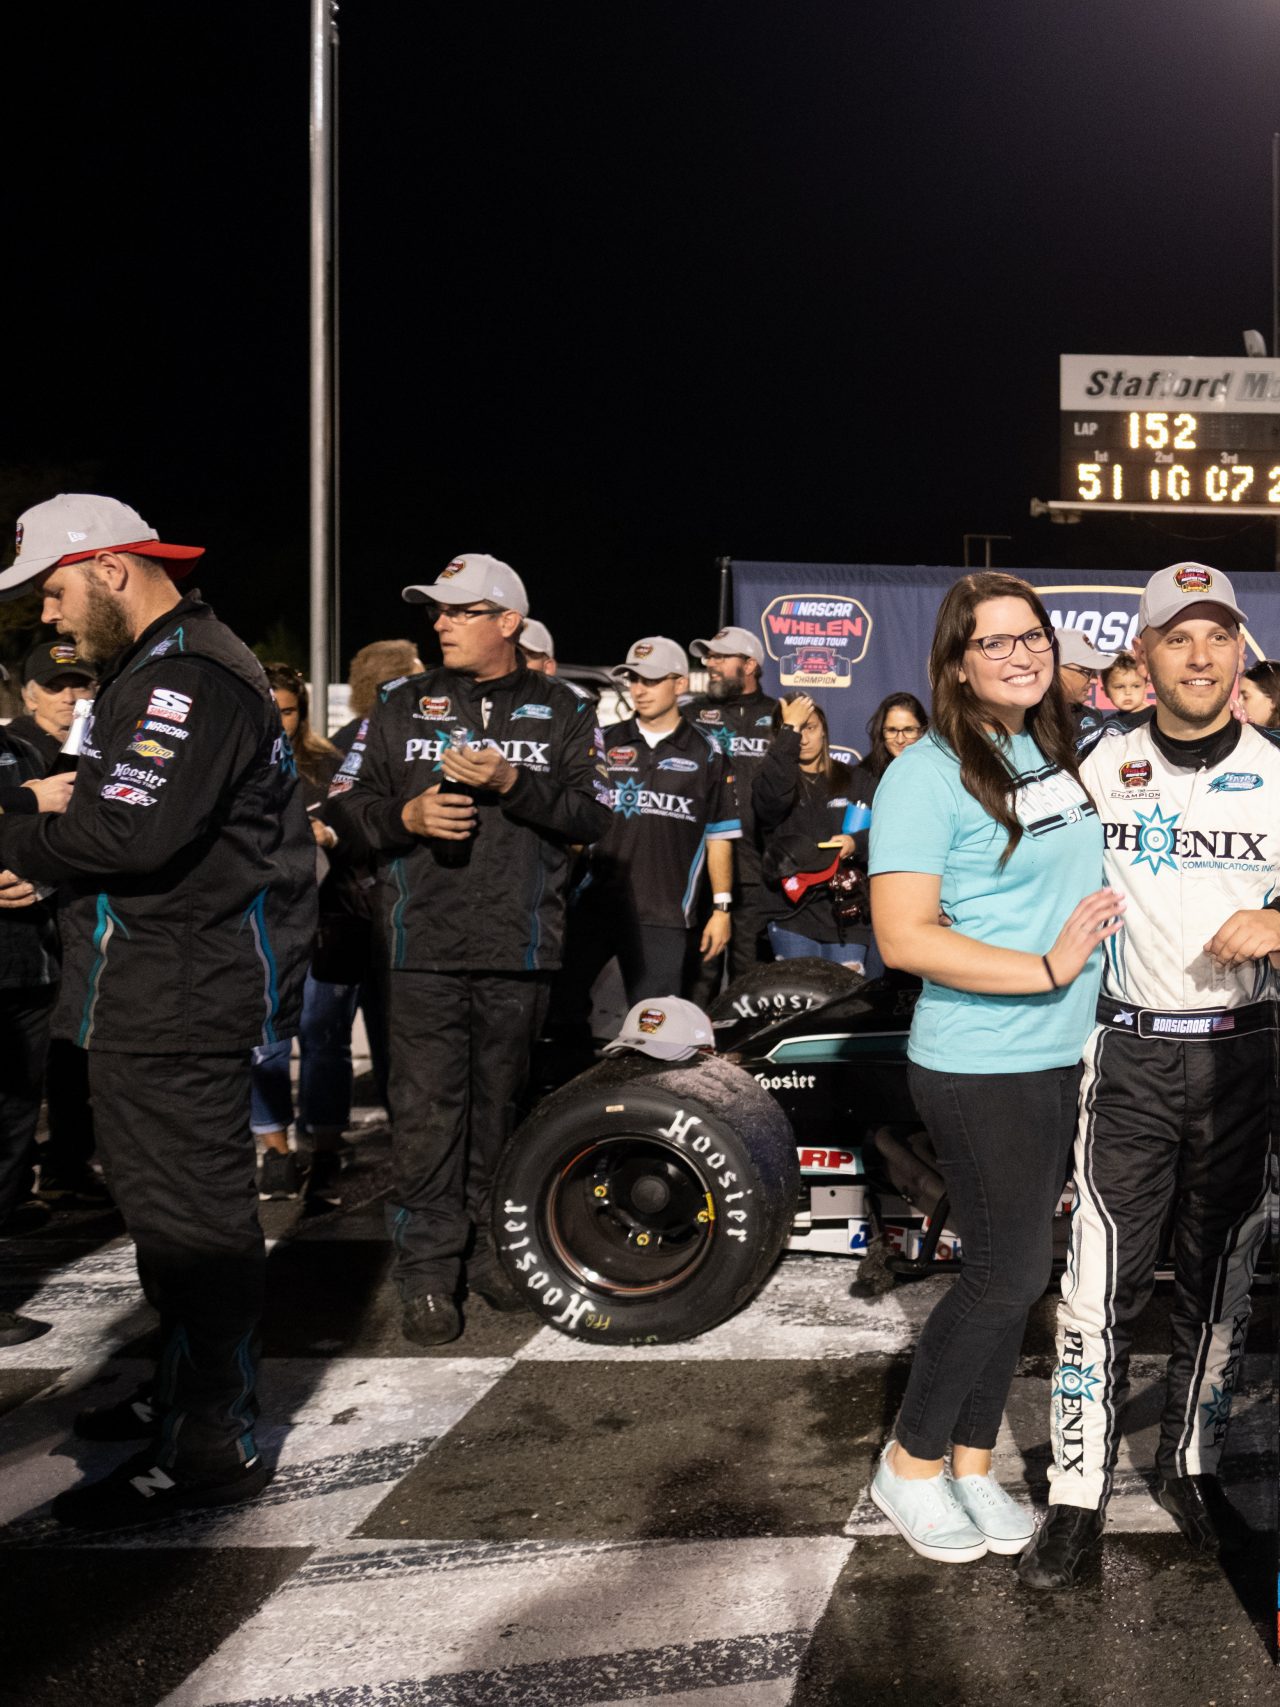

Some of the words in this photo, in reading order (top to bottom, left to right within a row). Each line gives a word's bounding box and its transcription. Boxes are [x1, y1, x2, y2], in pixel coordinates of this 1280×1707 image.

[1074, 422, 1098, 436] LAP
[1129, 411, 1197, 449] 152
[1094, 450, 1109, 463] 1st
[1155, 451, 1174, 463] 2nd
[1221, 452, 1239, 464] 3rd
[1077, 463, 1123, 500] 51
[1205, 465, 1254, 502] 07
[797, 601, 854, 617] NASCAR
[768, 614, 863, 637] WHELEN
[784, 636, 826, 646] MODIFIED
[826, 637, 848, 647] TOUR
[793, 675, 837, 685] CHAMPION
[148, 706, 185, 721] SIMPSON
[145, 720, 190, 740] NASCAR
[127, 741, 174, 760] SUNOCO
[404, 738, 550, 765] PHENIX
[110, 762, 168, 787] Hoosier
[1066, 807, 1082, 824] 51
[1181, 860, 1260, 873] COMMUNICATIONS
[732, 991, 813, 1018] Hoosi
[1151, 1017, 1212, 1034] BONSIGNORE
[800, 1149, 854, 1169] RP
[659, 1109, 753, 1243] Hoosier
[502, 1199, 595, 1330] Hoosier
